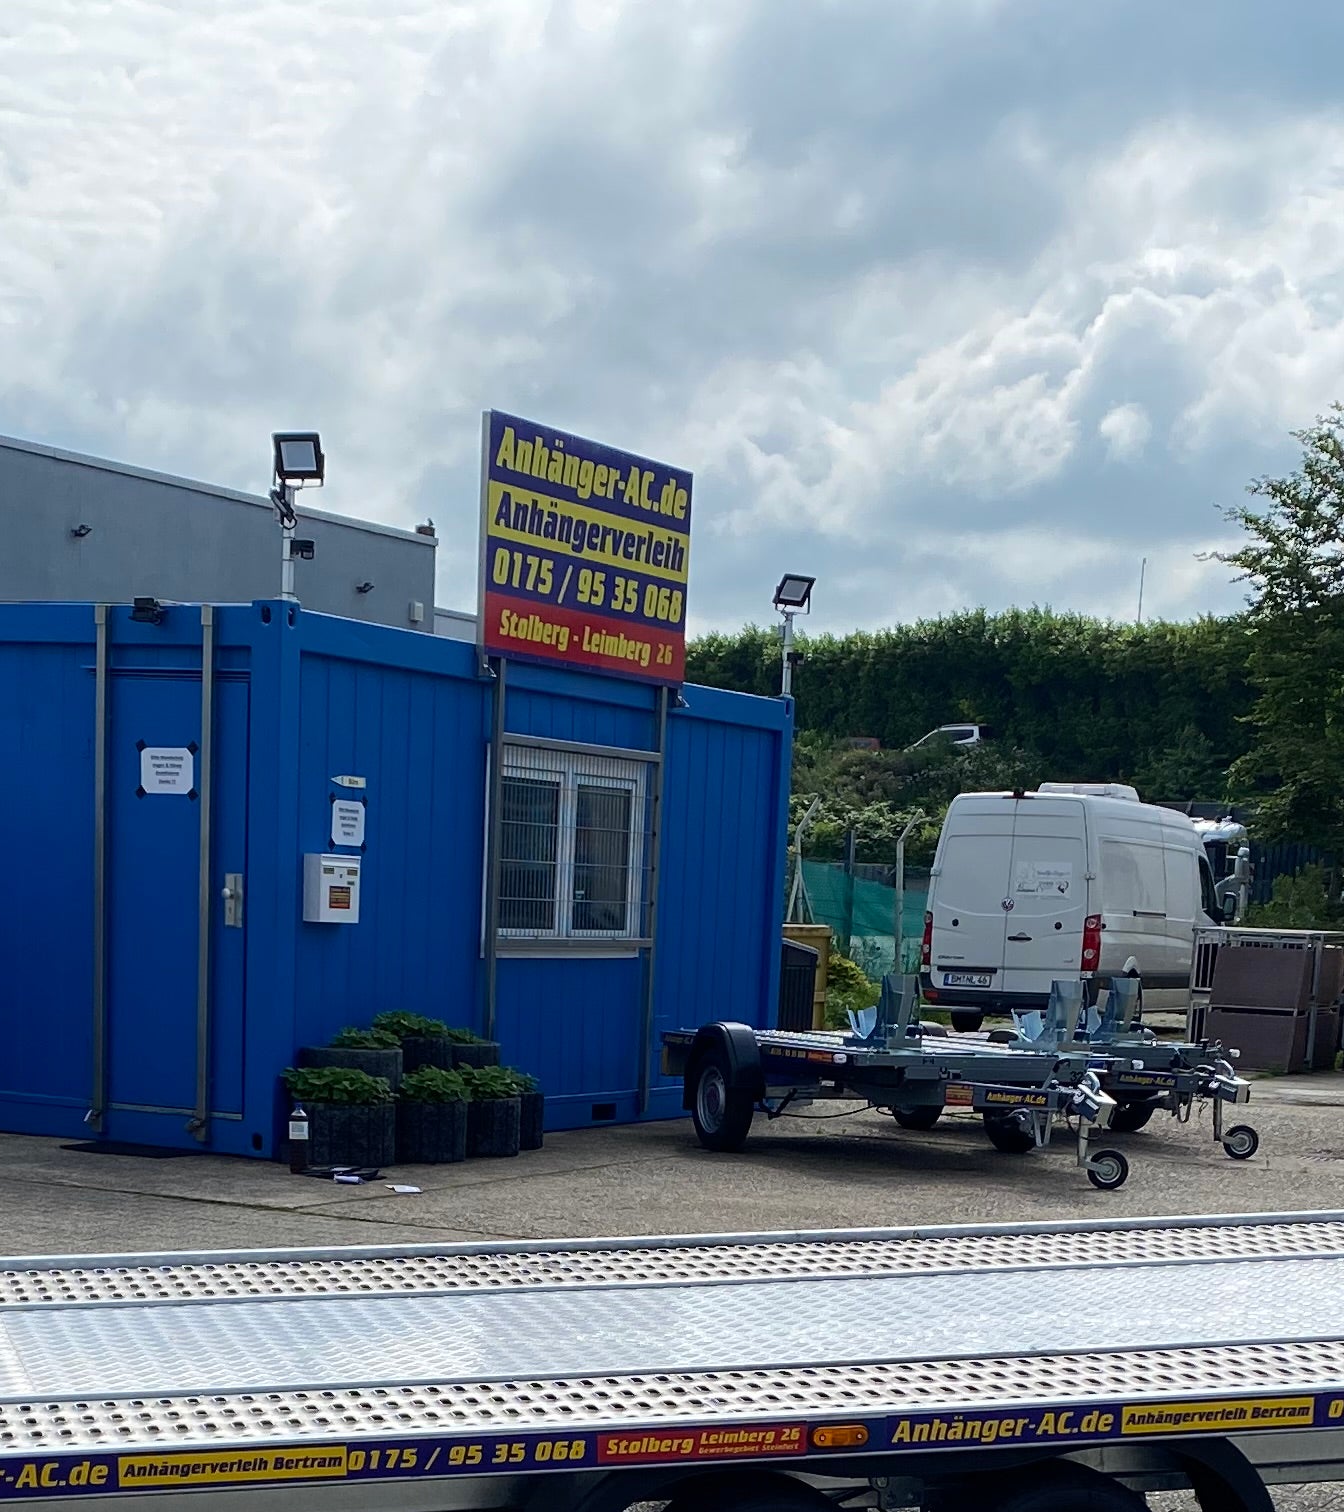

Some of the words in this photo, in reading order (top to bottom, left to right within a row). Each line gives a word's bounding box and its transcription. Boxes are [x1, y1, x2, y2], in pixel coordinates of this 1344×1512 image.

[496, 426, 687, 520] Anhänger-AC.de
[495, 492, 684, 573] Anhängerverleih
[493, 548, 555, 595] 0175
[577, 569, 605, 606] 95
[611, 576, 638, 613] 35
[643, 584, 682, 623] 068
[499, 609, 570, 652] Stolberg
[582, 625, 651, 667] Leimberg
[656, 643, 673, 666] 26
[987, 1091, 1047, 1105] Anhänger-AC.de
[891, 1410, 1114, 1443] Anhänger-AC.de
[1126, 1406, 1247, 1427] Anhängerverleih
[1251, 1404, 1310, 1420] Bertram
[123, 1457, 268, 1479] Anhängerverleih
[273, 1455, 342, 1472] Bertram
[348, 1448, 417, 1472] 0175
[448, 1445, 483, 1466] 95
[491, 1442, 526, 1464] 35
[534, 1440, 586, 1462] 068
[606, 1437, 694, 1456] Stolberg
[700, 1429, 775, 1445] Leimberg
[781, 1428, 800, 1441] 26
